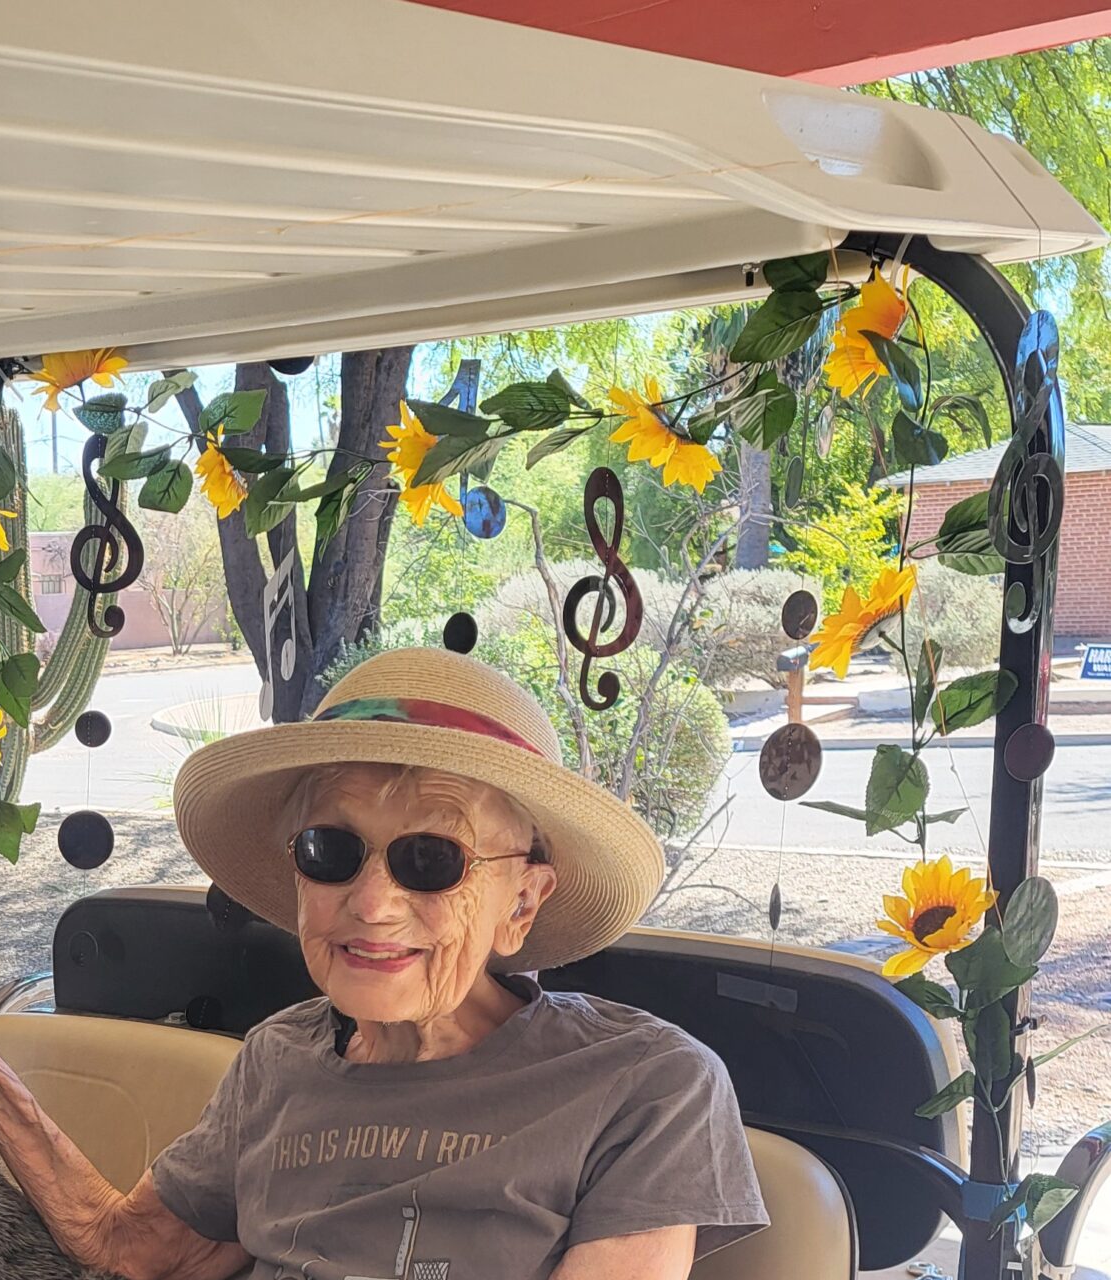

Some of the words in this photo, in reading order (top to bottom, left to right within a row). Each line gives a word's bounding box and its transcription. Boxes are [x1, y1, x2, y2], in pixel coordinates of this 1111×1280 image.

[270, 1133, 313, 1172] THIS
[317, 1129, 339, 1164] IS
[343, 1125, 411, 1159] HOW
[416, 1128, 429, 1161] I
[436, 1131, 507, 1166] RO
